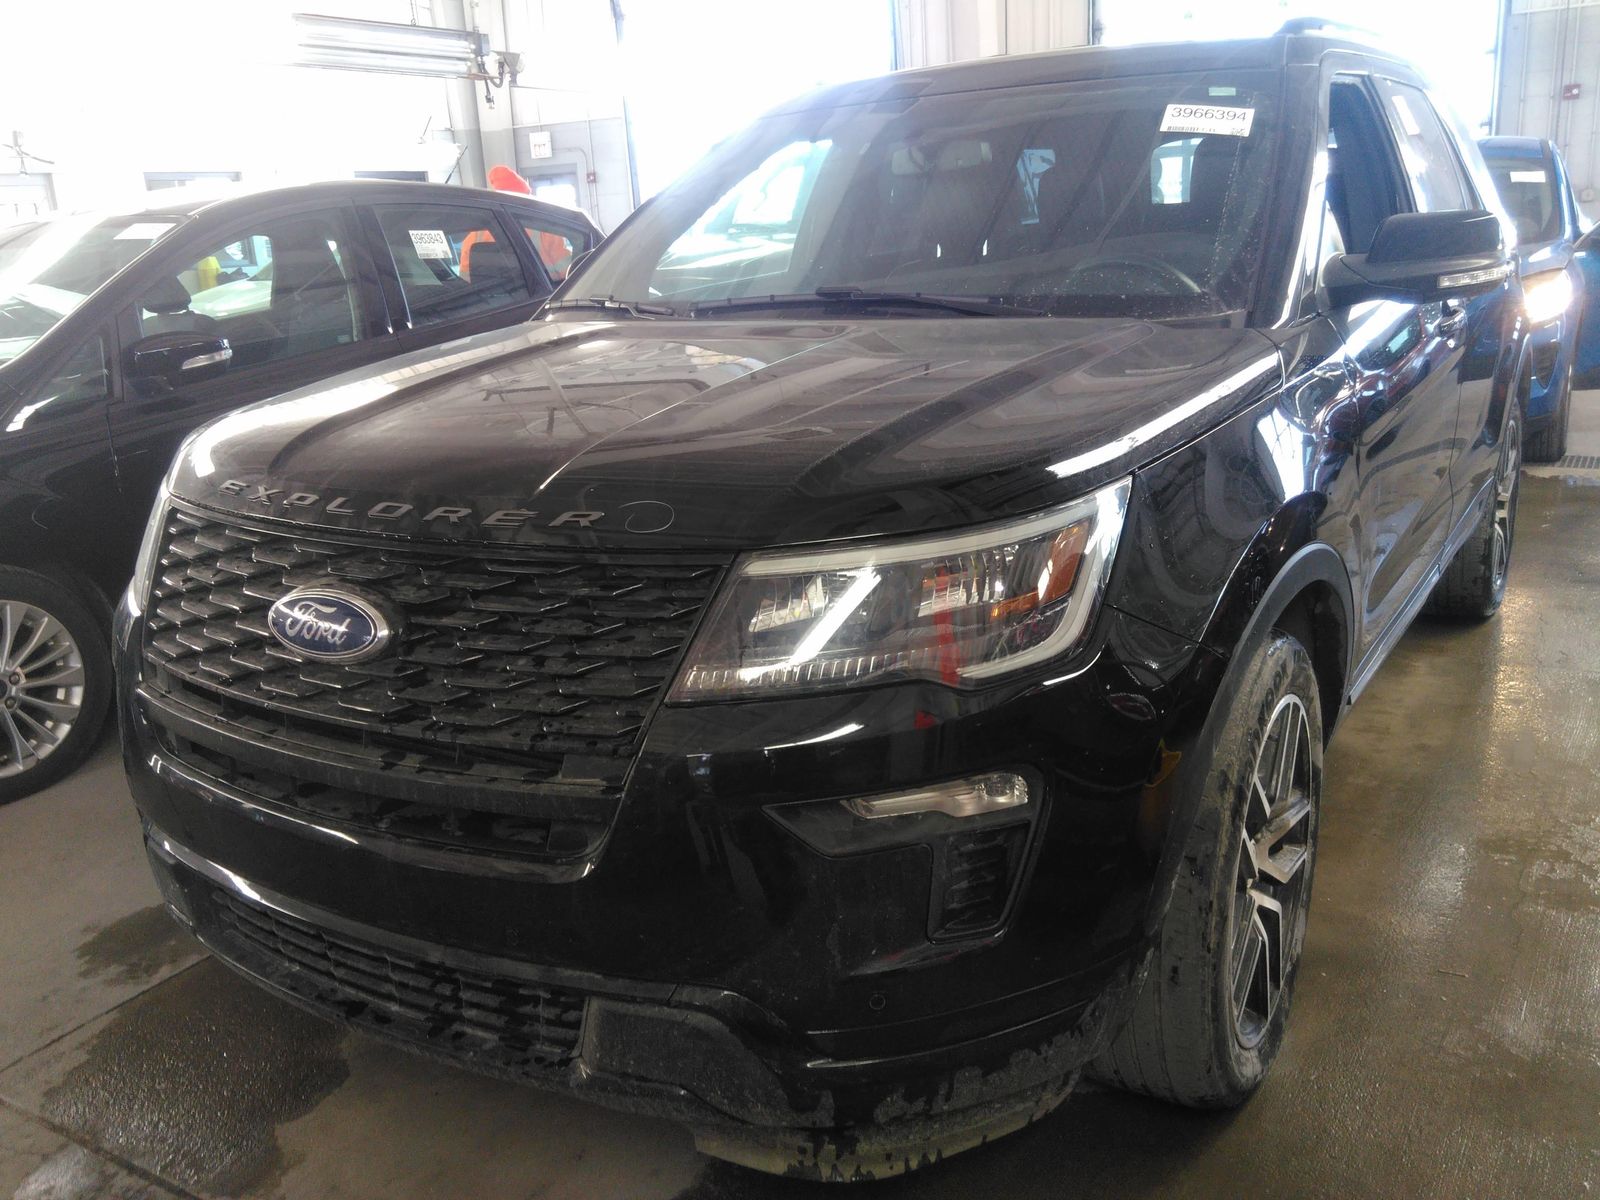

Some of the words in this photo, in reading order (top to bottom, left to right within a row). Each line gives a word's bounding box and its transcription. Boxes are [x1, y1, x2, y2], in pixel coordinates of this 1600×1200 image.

[1171, 107, 1247, 121] 3966394
[218, 479, 604, 528] EXPLORER
[285, 601, 351, 645] Ford
